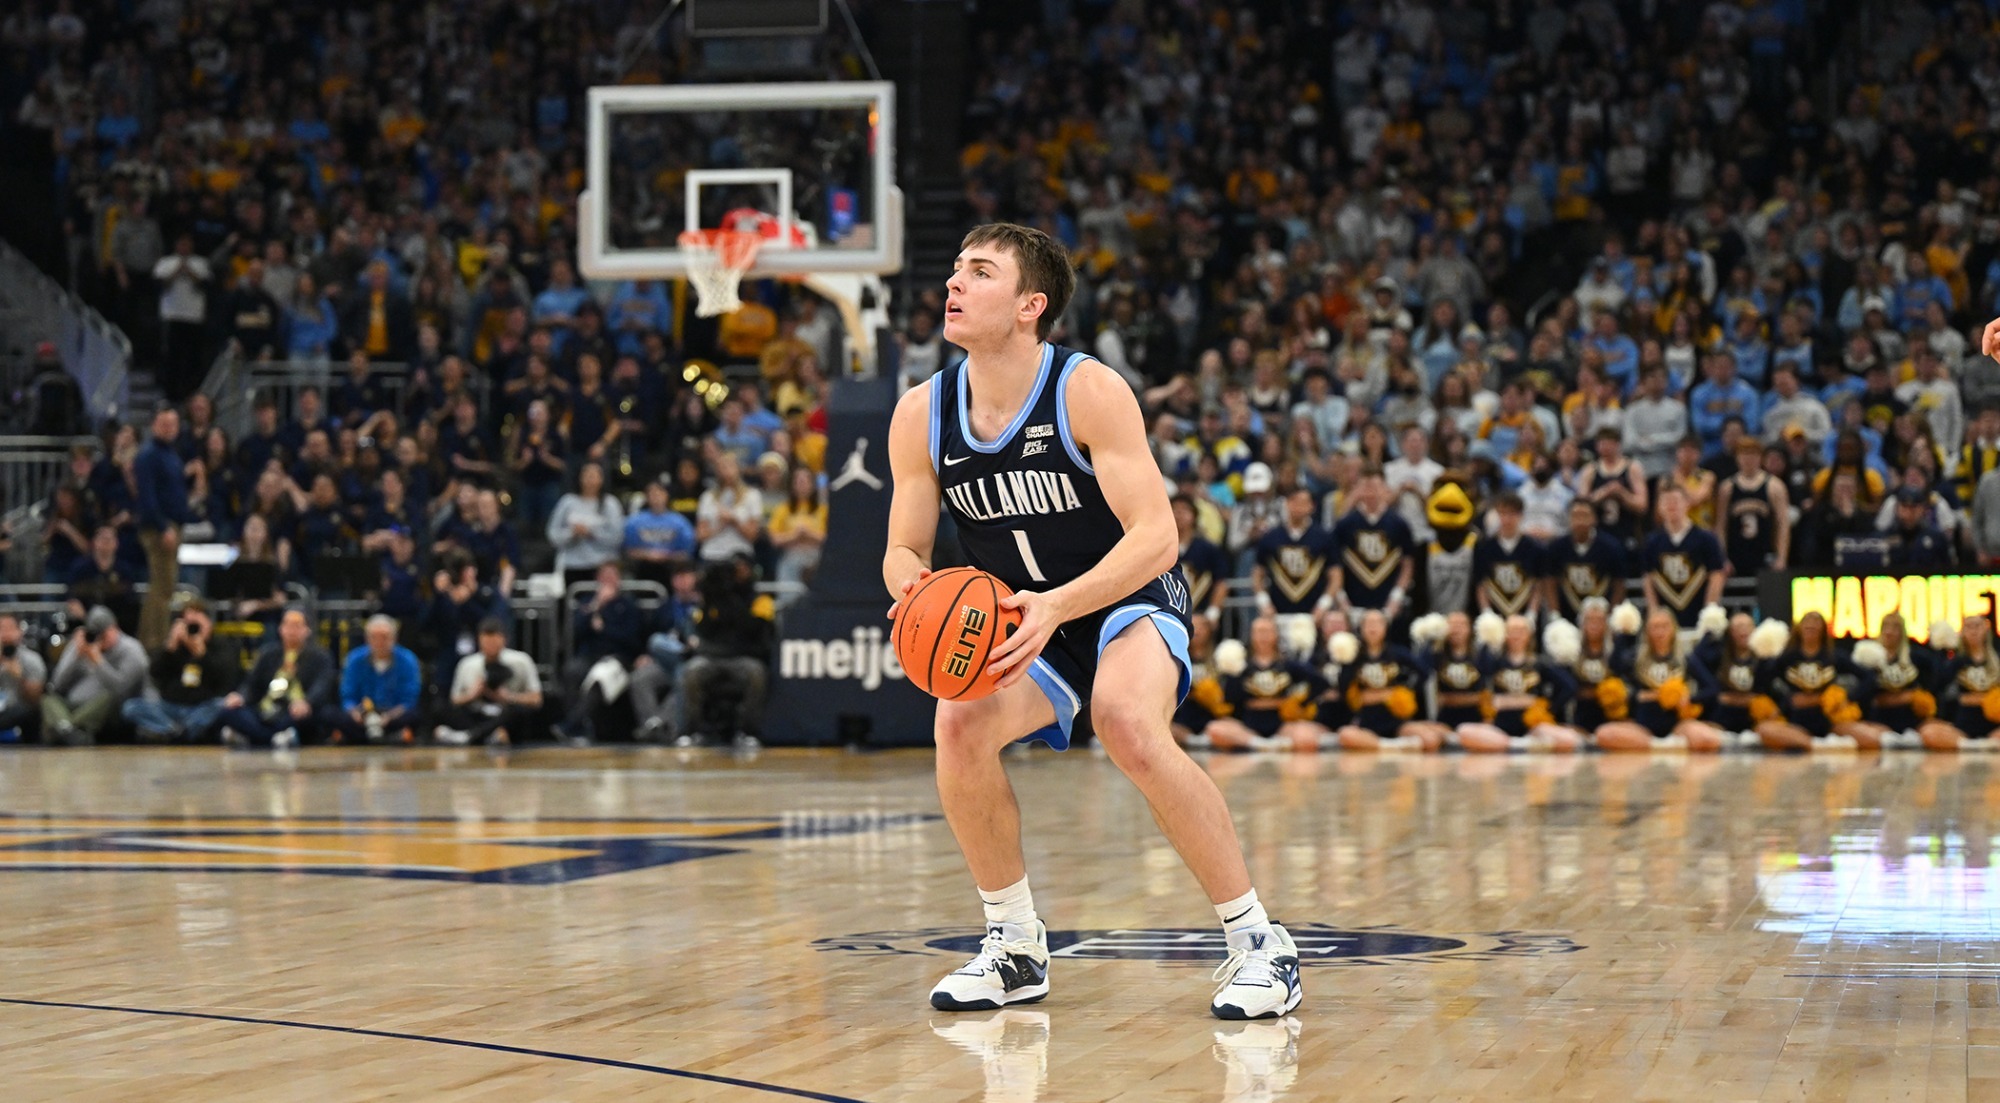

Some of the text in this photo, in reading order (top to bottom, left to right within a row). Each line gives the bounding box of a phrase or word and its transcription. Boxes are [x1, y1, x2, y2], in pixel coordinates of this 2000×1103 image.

[1023, 445, 1048, 454] EAST
[1024, 440, 1042, 450] BIG
[946, 470, 1083, 521] VILLANOVA
[1011, 529, 1049, 582] 1
[780, 626, 906, 690] meije
[947, 607, 988, 678] ELITE
